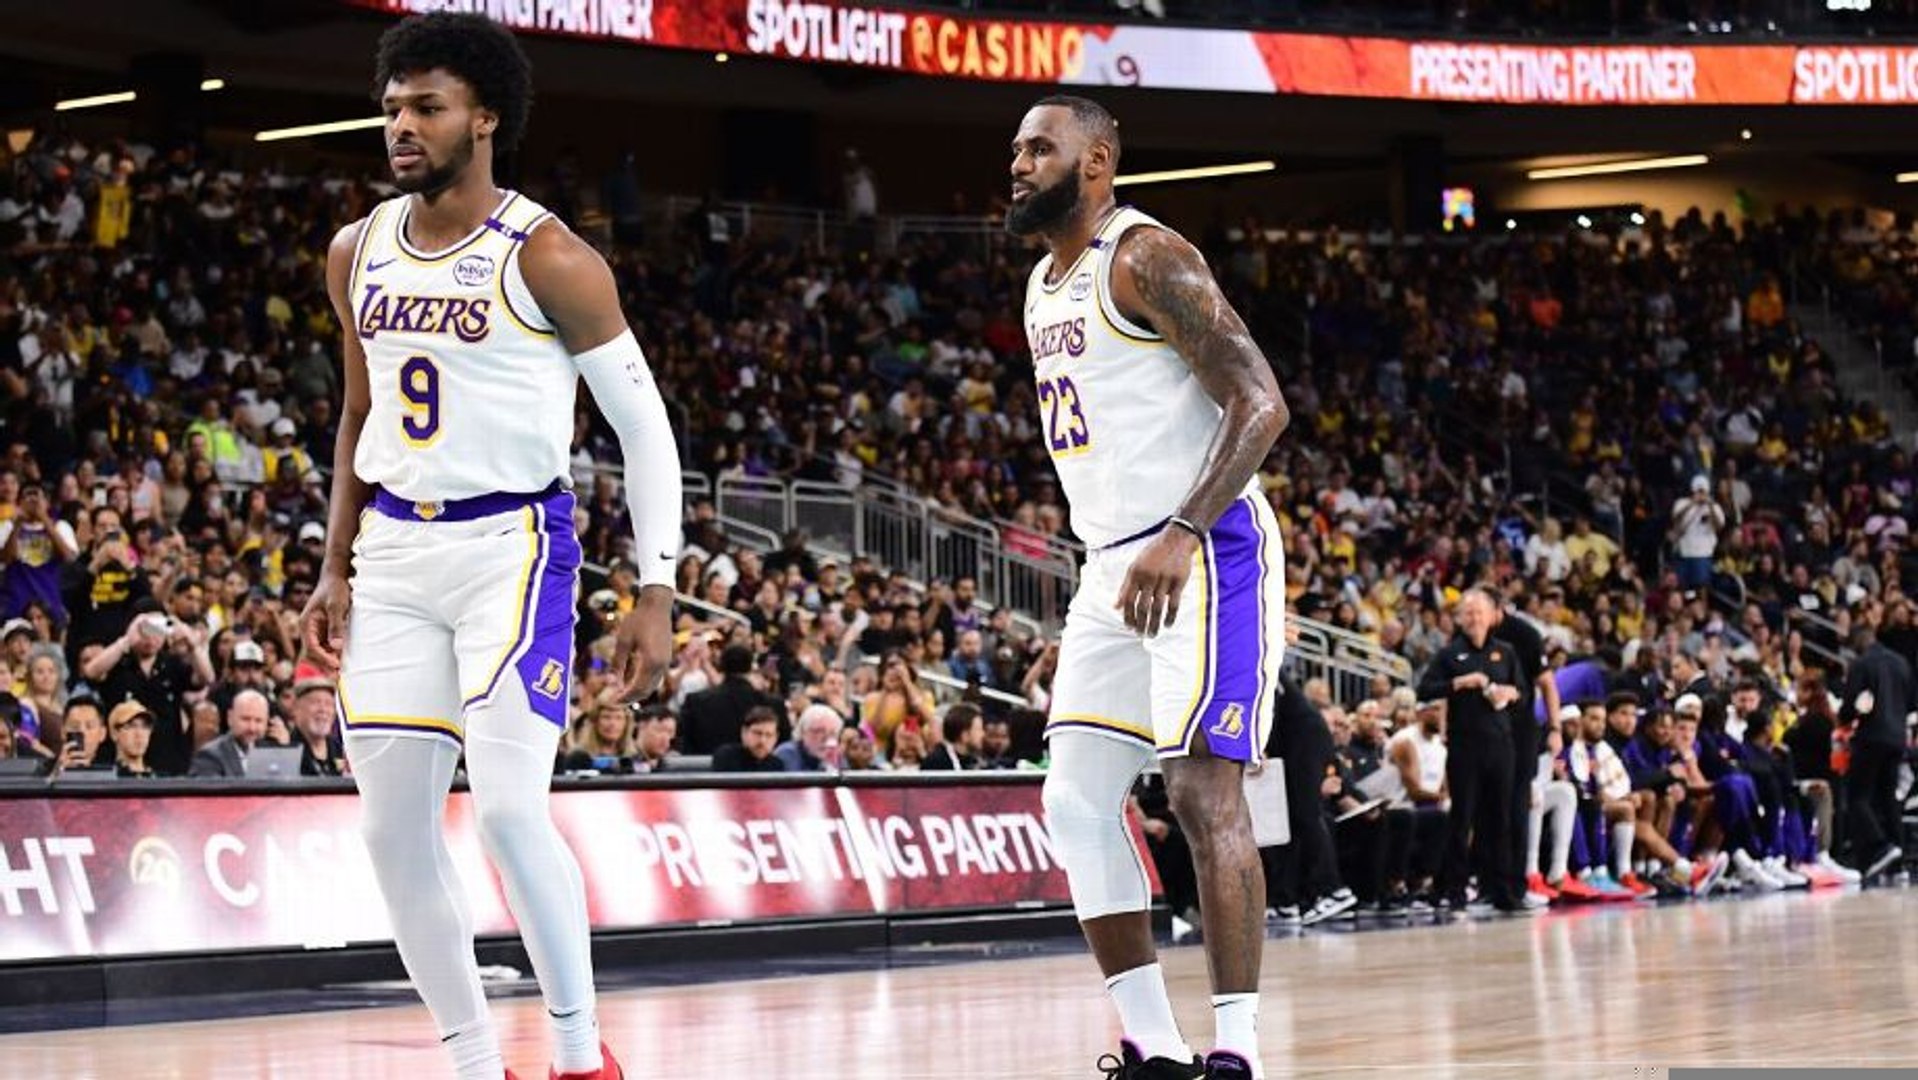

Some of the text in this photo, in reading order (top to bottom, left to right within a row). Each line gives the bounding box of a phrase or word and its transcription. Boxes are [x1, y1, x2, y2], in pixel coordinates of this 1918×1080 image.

[746, 0, 906, 67] SPOTLIGHT
[937, 19, 1083, 78] CASINO
[1410, 43, 1696, 100] PRESENTING PARTNER
[359, 283, 491, 343] LAKERS
[399, 354, 441, 443] 9
[1038, 374, 1091, 453] 23
[919, 813, 1066, 876] PARTN
